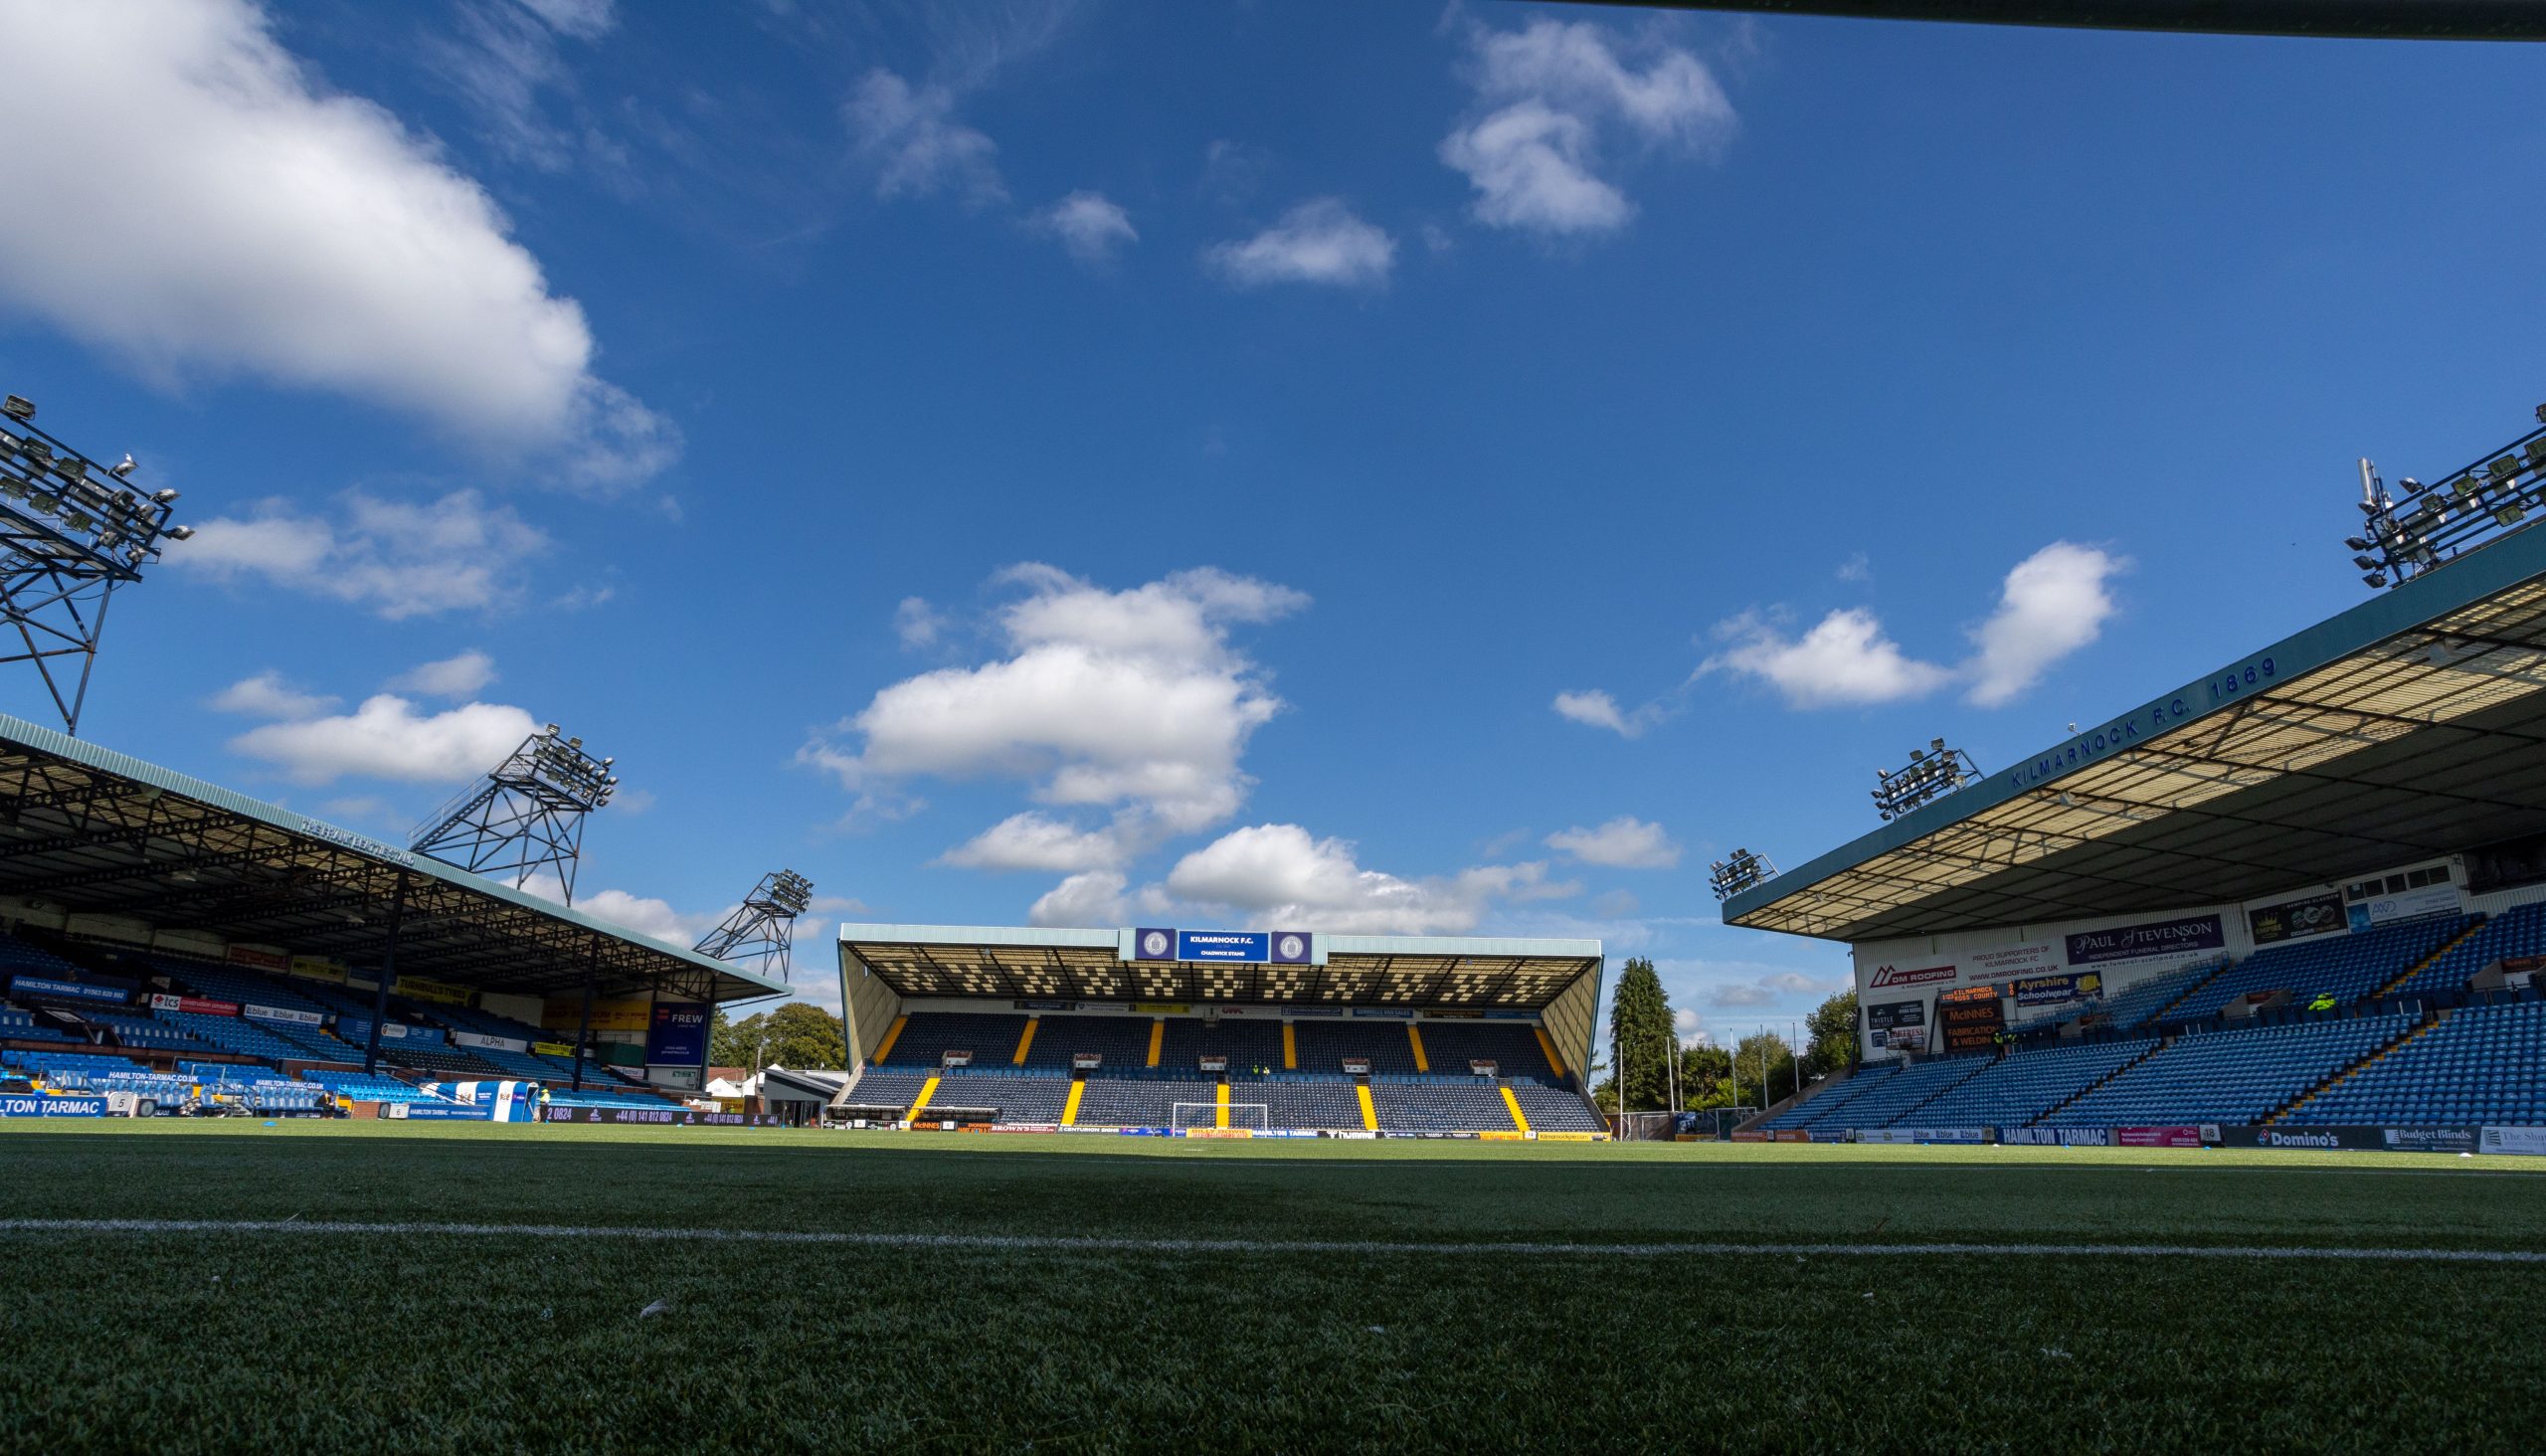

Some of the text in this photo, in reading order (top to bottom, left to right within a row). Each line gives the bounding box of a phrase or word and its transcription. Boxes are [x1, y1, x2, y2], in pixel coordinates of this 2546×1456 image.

[2012, 656, 2277, 789] KILMARNOCK F.C. 1869
[2075, 921, 2212, 955] PAUL STEVENSON
[1996, 947, 2040, 960] SUPPORTERS
[2090, 941, 2199, 961] INDEPENDENT FUNERAL DIRECTORS
[1985, 957, 2028, 967] KILMARNOCK
[1910, 970, 1955, 982] ROOFING
[14, 979, 51, 991] HAMILTON
[53, 984, 80, 994] TARMAC
[2019, 977, 2070, 992] Ayrshire
[1953, 986, 1994, 996] KILMARNOCK
[1973, 992, 1998, 1001] COUNTY
[2017, 989, 2072, 1001] Schoolwear
[164, 996, 179, 1007] tcs
[671, 1012, 703, 1024] FREW
[1949, 1007, 1995, 1022] McINNES
[1947, 1025, 1999, 1037] FABRICATION
[479, 1035, 505, 1048] ALPHA
[1960, 1035, 1992, 1045] WELDIN
[108, 1071, 199, 1083] HAMILTON-TARMAC.CO.UK
[256, 1078, 324, 1090] HAMILTON-TARMAC.CO.UK
[42, 1100, 100, 1114] TARMAC
[117, 1098, 125, 1108] 5
[553, 1107, 573, 1121] 0824
[616, 1110, 673, 1123] +44 (0) 141 812 0824
[1339, 1131, 1376, 1140] hummel
[1917, 1130, 1979, 1139] blue blue blue
[2003, 1128, 2106, 1146] HAMILTON TARMAC
[2205, 1128, 2215, 1138] 18
[2271, 1131, 2339, 1147] Domino's
[2400, 1129, 2471, 1142] Budget Blinds
[2502, 1131, 2546, 1142] The Shu
